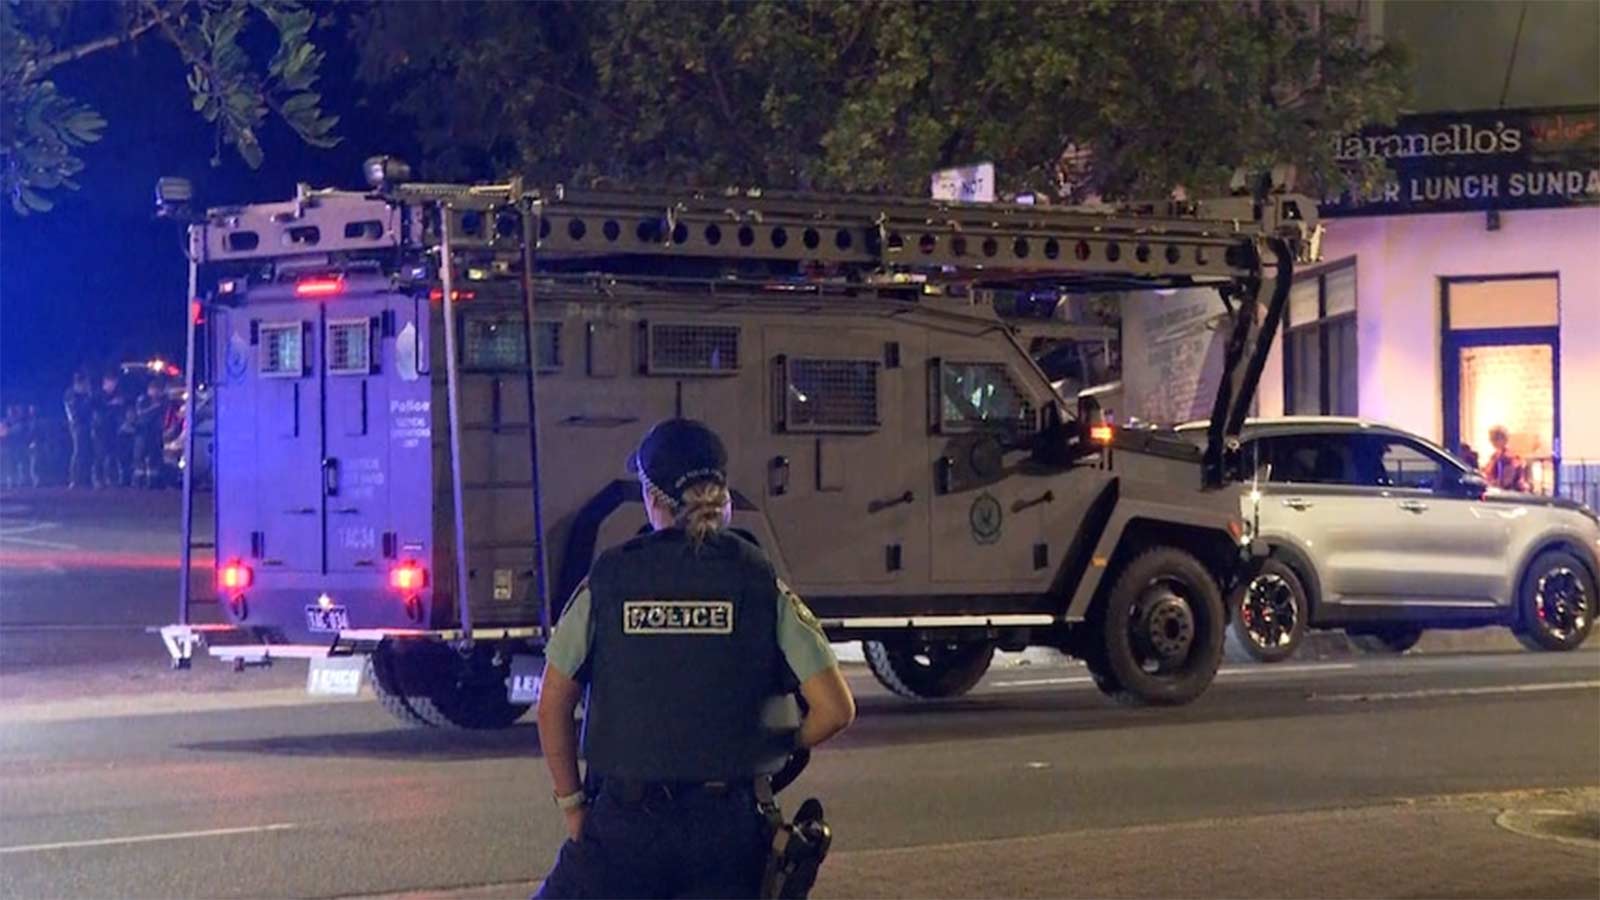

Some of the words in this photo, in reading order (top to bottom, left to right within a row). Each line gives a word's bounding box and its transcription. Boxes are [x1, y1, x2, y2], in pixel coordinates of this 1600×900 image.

[1410, 175, 1498, 202] LUNCH
[1508, 169, 1600, 197] SUNDA
[630, 606, 726, 628] POLICE
